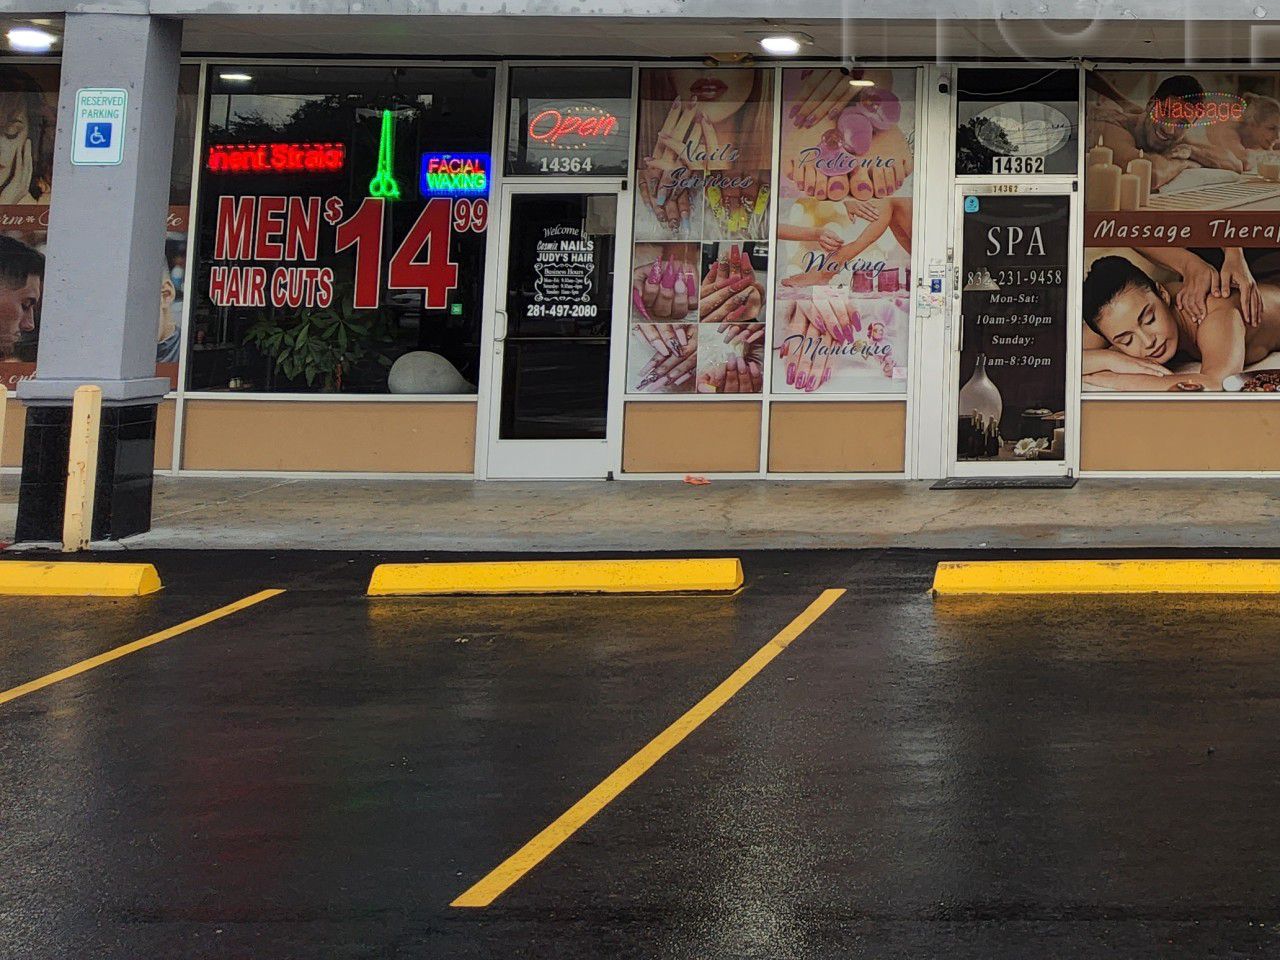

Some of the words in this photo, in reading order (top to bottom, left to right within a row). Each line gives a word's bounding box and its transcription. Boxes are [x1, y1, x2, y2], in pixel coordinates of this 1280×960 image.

[81, 96, 124, 106] RESERVED
[81, 109, 120, 119] PARKING
[1154, 97, 1244, 122] Massage
[528, 108, 617, 143] Open
[680, 139, 740, 163] Nails
[799, 148, 896, 170] Pedicure
[428, 158, 485, 173] FACIAL
[540, 157, 592, 172] 14364
[995, 157, 1044, 173] 14362
[426, 172, 487, 191] WAXING
[663, 166, 753, 189] Services
[993, 185, 1018, 193] 14362
[214, 196, 321, 261] MEN
[543, 224, 580, 237] Welcome
[1094, 220, 1191, 242] Massage
[536, 240, 558, 251] Cosmix
[560, 240, 594, 251] NAILS
[986, 226, 1046, 256] SPA
[537, 253, 569, 262] JUDY'S
[571, 253, 593, 262] HAIR
[802, 251, 887, 278] Waxing
[967, 270, 1062, 286] 832-231-9458
[209, 266, 267, 307] HAIR
[271, 267, 333, 308] CUTS
[990, 293, 1039, 304] Mon-Sat:
[527, 304, 598, 317] 281-497-2080
[976, 314, 1052, 327] 10am-9:30pm
[785, 335, 893, 361] Manicure
[991, 335, 1034, 346] Sunday:
